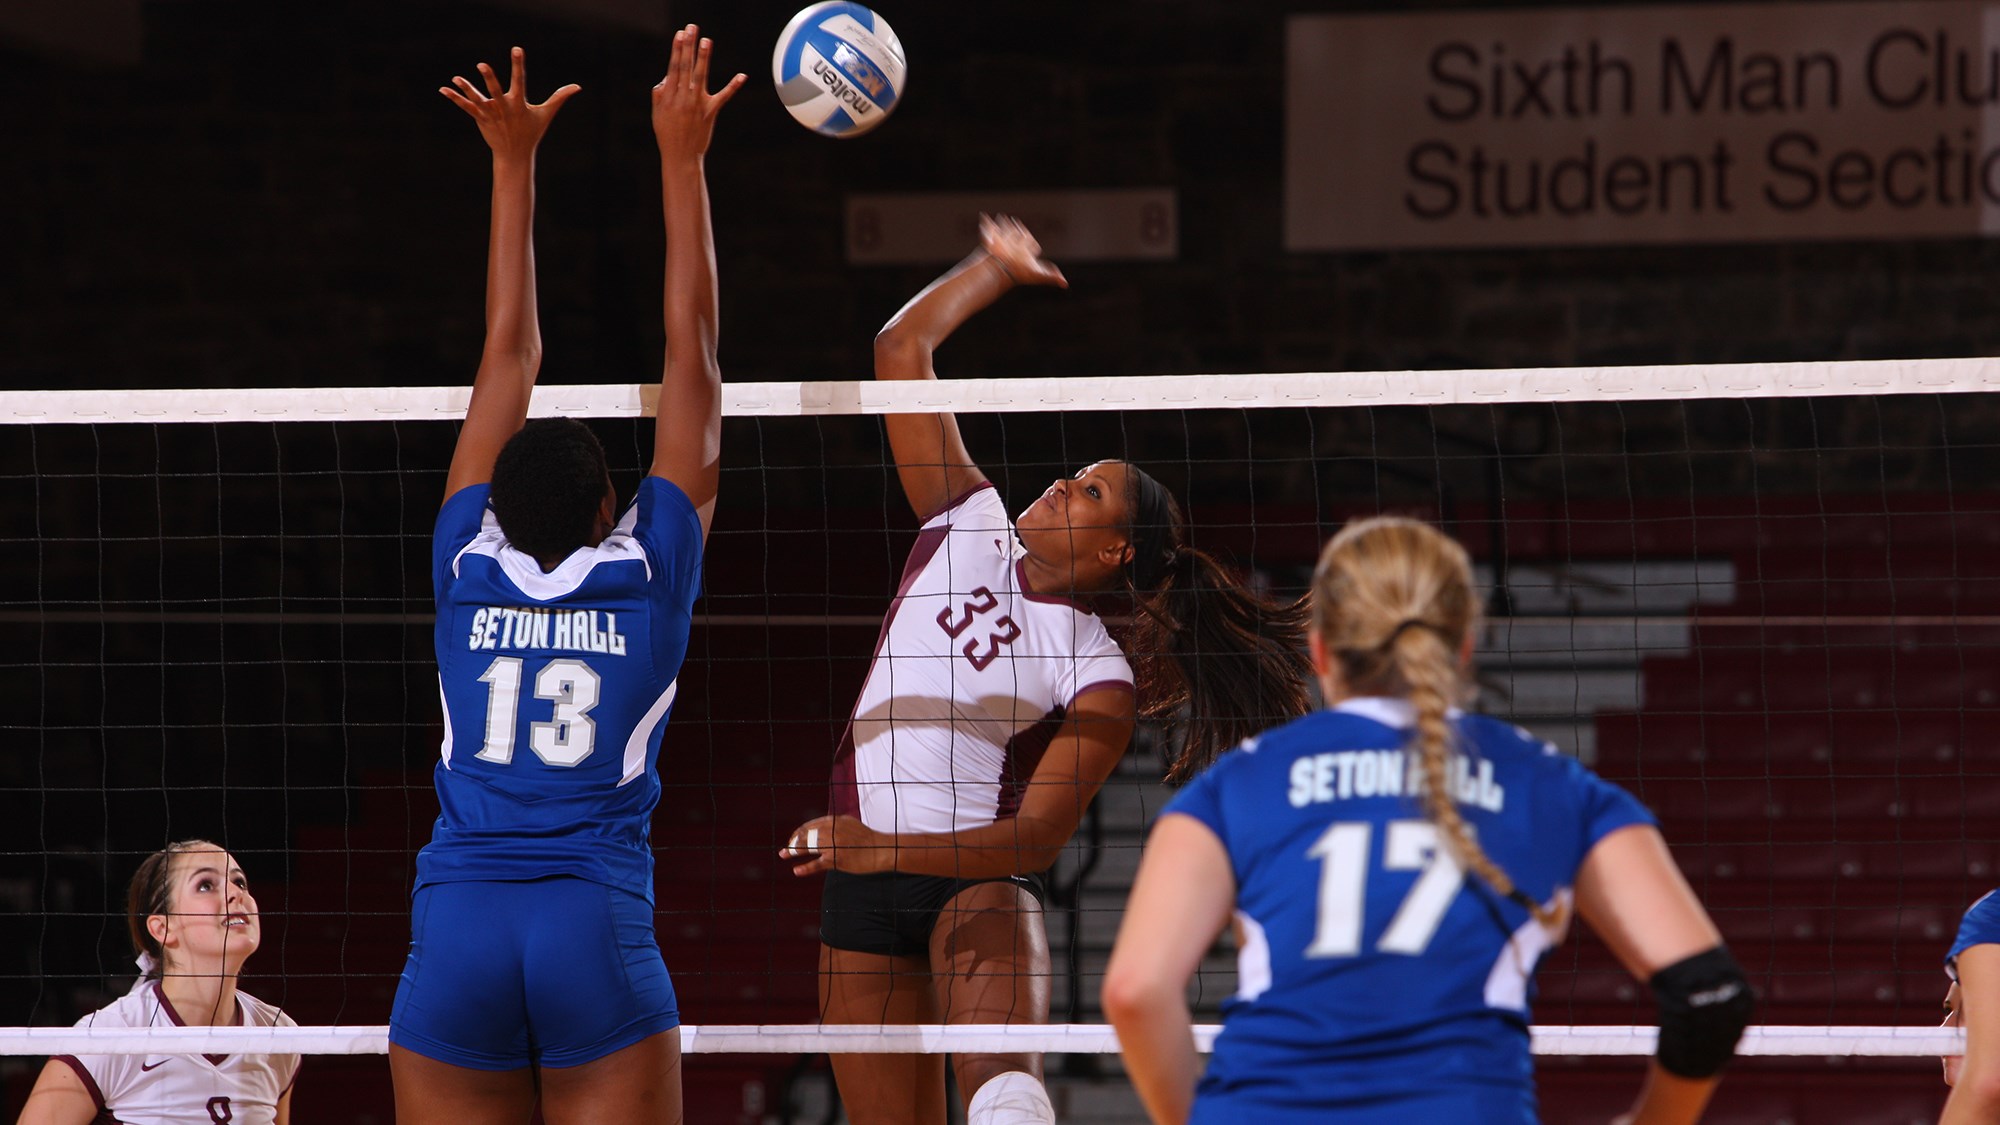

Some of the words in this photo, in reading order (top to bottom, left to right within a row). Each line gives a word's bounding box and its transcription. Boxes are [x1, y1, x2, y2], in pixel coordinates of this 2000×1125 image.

[812, 60, 872, 114] molten
[1427, 38, 1634, 122] Sixth
[1659, 36, 1841, 116] Man
[1866, 28, 2000, 110] Clu
[1406, 137, 1735, 220] Student
[469, 607, 549, 651] SETON
[552, 608, 627, 656] HALL
[936, 585, 1021, 672] 33
[474, 656, 601, 768] 13
[1288, 749, 1404, 808] SETON
[1405, 751, 1504, 813] HLL
[1303, 820, 1478, 960] 17
